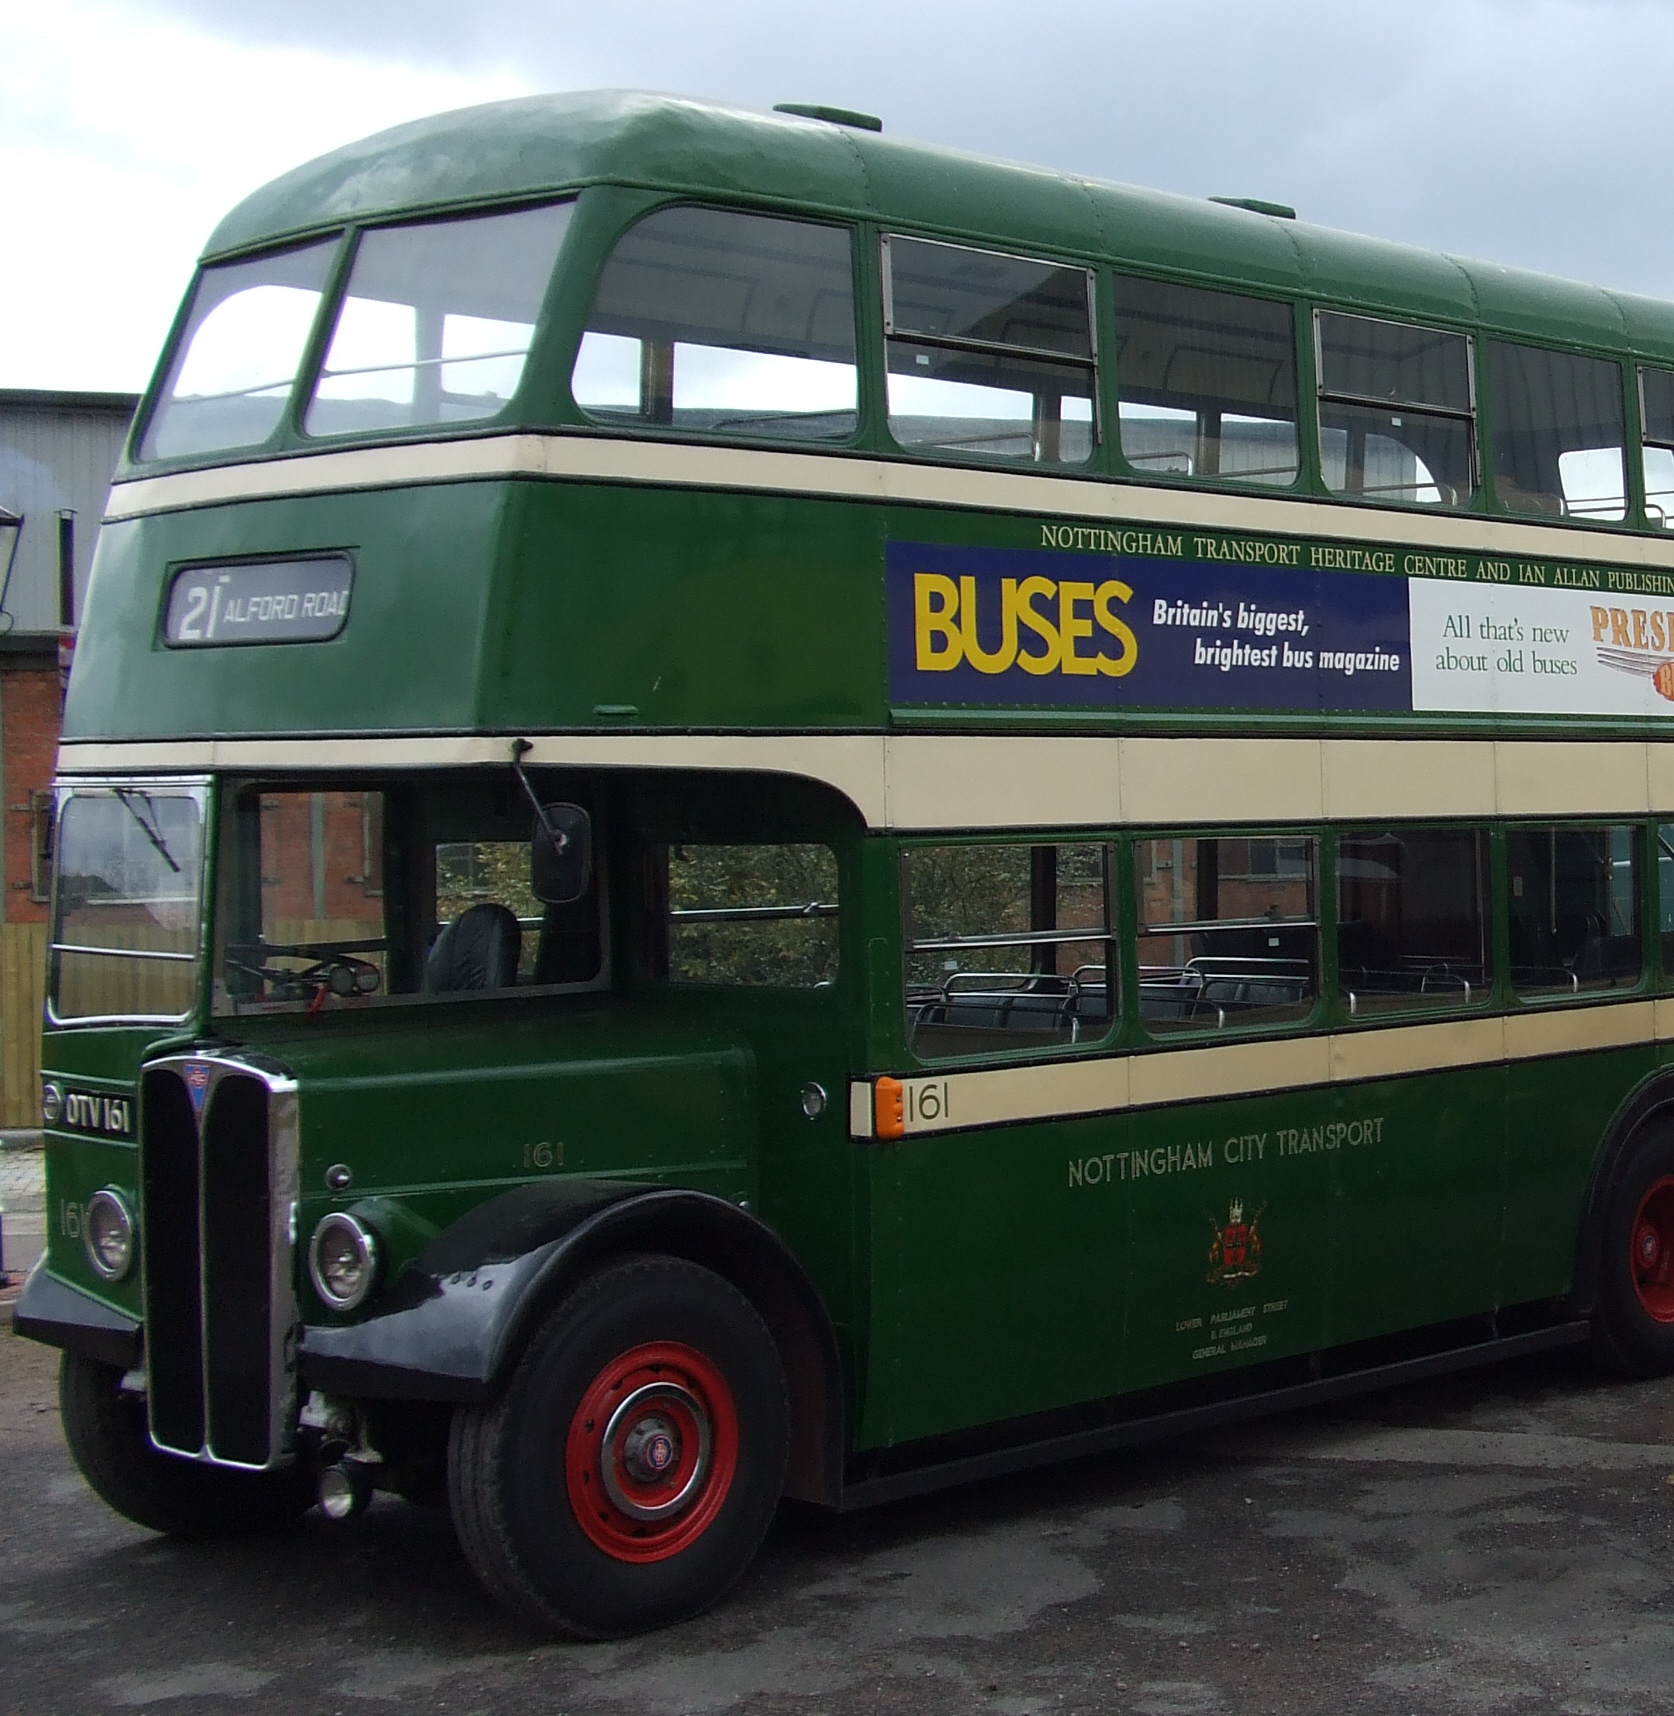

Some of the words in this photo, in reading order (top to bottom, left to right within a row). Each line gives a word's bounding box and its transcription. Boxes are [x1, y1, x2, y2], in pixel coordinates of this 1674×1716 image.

[1040, 524, 1183, 556] NOTTINGHAM
[1193, 537, 1301, 565] TRANSPORT
[1310, 546, 1396, 573] HERITAGE
[1403, 554, 1467, 578] CENTRE
[1475, 561, 1511, 582] AND
[1518, 564, 1546, 584] IAN
[1552, 567, 1601, 588] ALLAN
[178, 585, 222, 640] 21
[223, 594, 300, 623] ALFORD
[914, 572, 1138, 678] BUSES
[1152, 599, 1232, 629] Britain's
[1237, 602, 1310, 637] biggest,
[1442, 614, 1471, 639] All
[1532, 626, 1570, 644] new
[1194, 638, 1278, 672] brightest
[1282, 641, 1314, 669] bus
[1318, 646, 1400, 676] magazine
[1435, 646, 1488, 672] about
[1496, 649, 1525, 673] old
[1531, 650, 1578, 675] buses
[66, 1094, 100, 1128] OTV
[103, 1098, 129, 1133] 161
[908, 1082, 949, 1123] 161
[523, 1141, 565, 1168] 161
[1068, 1140, 1213, 1188] NOTTINGHAM
[1224, 1132, 1268, 1164] CITY
[1276, 1117, 1384, 1156] TRANSPORT
[1175, 1317, 1203, 1332] LOWER
[1210, 1306, 1256, 1325] PARLIAMENT
[1192, 1344, 1227, 1360] GENERAL
